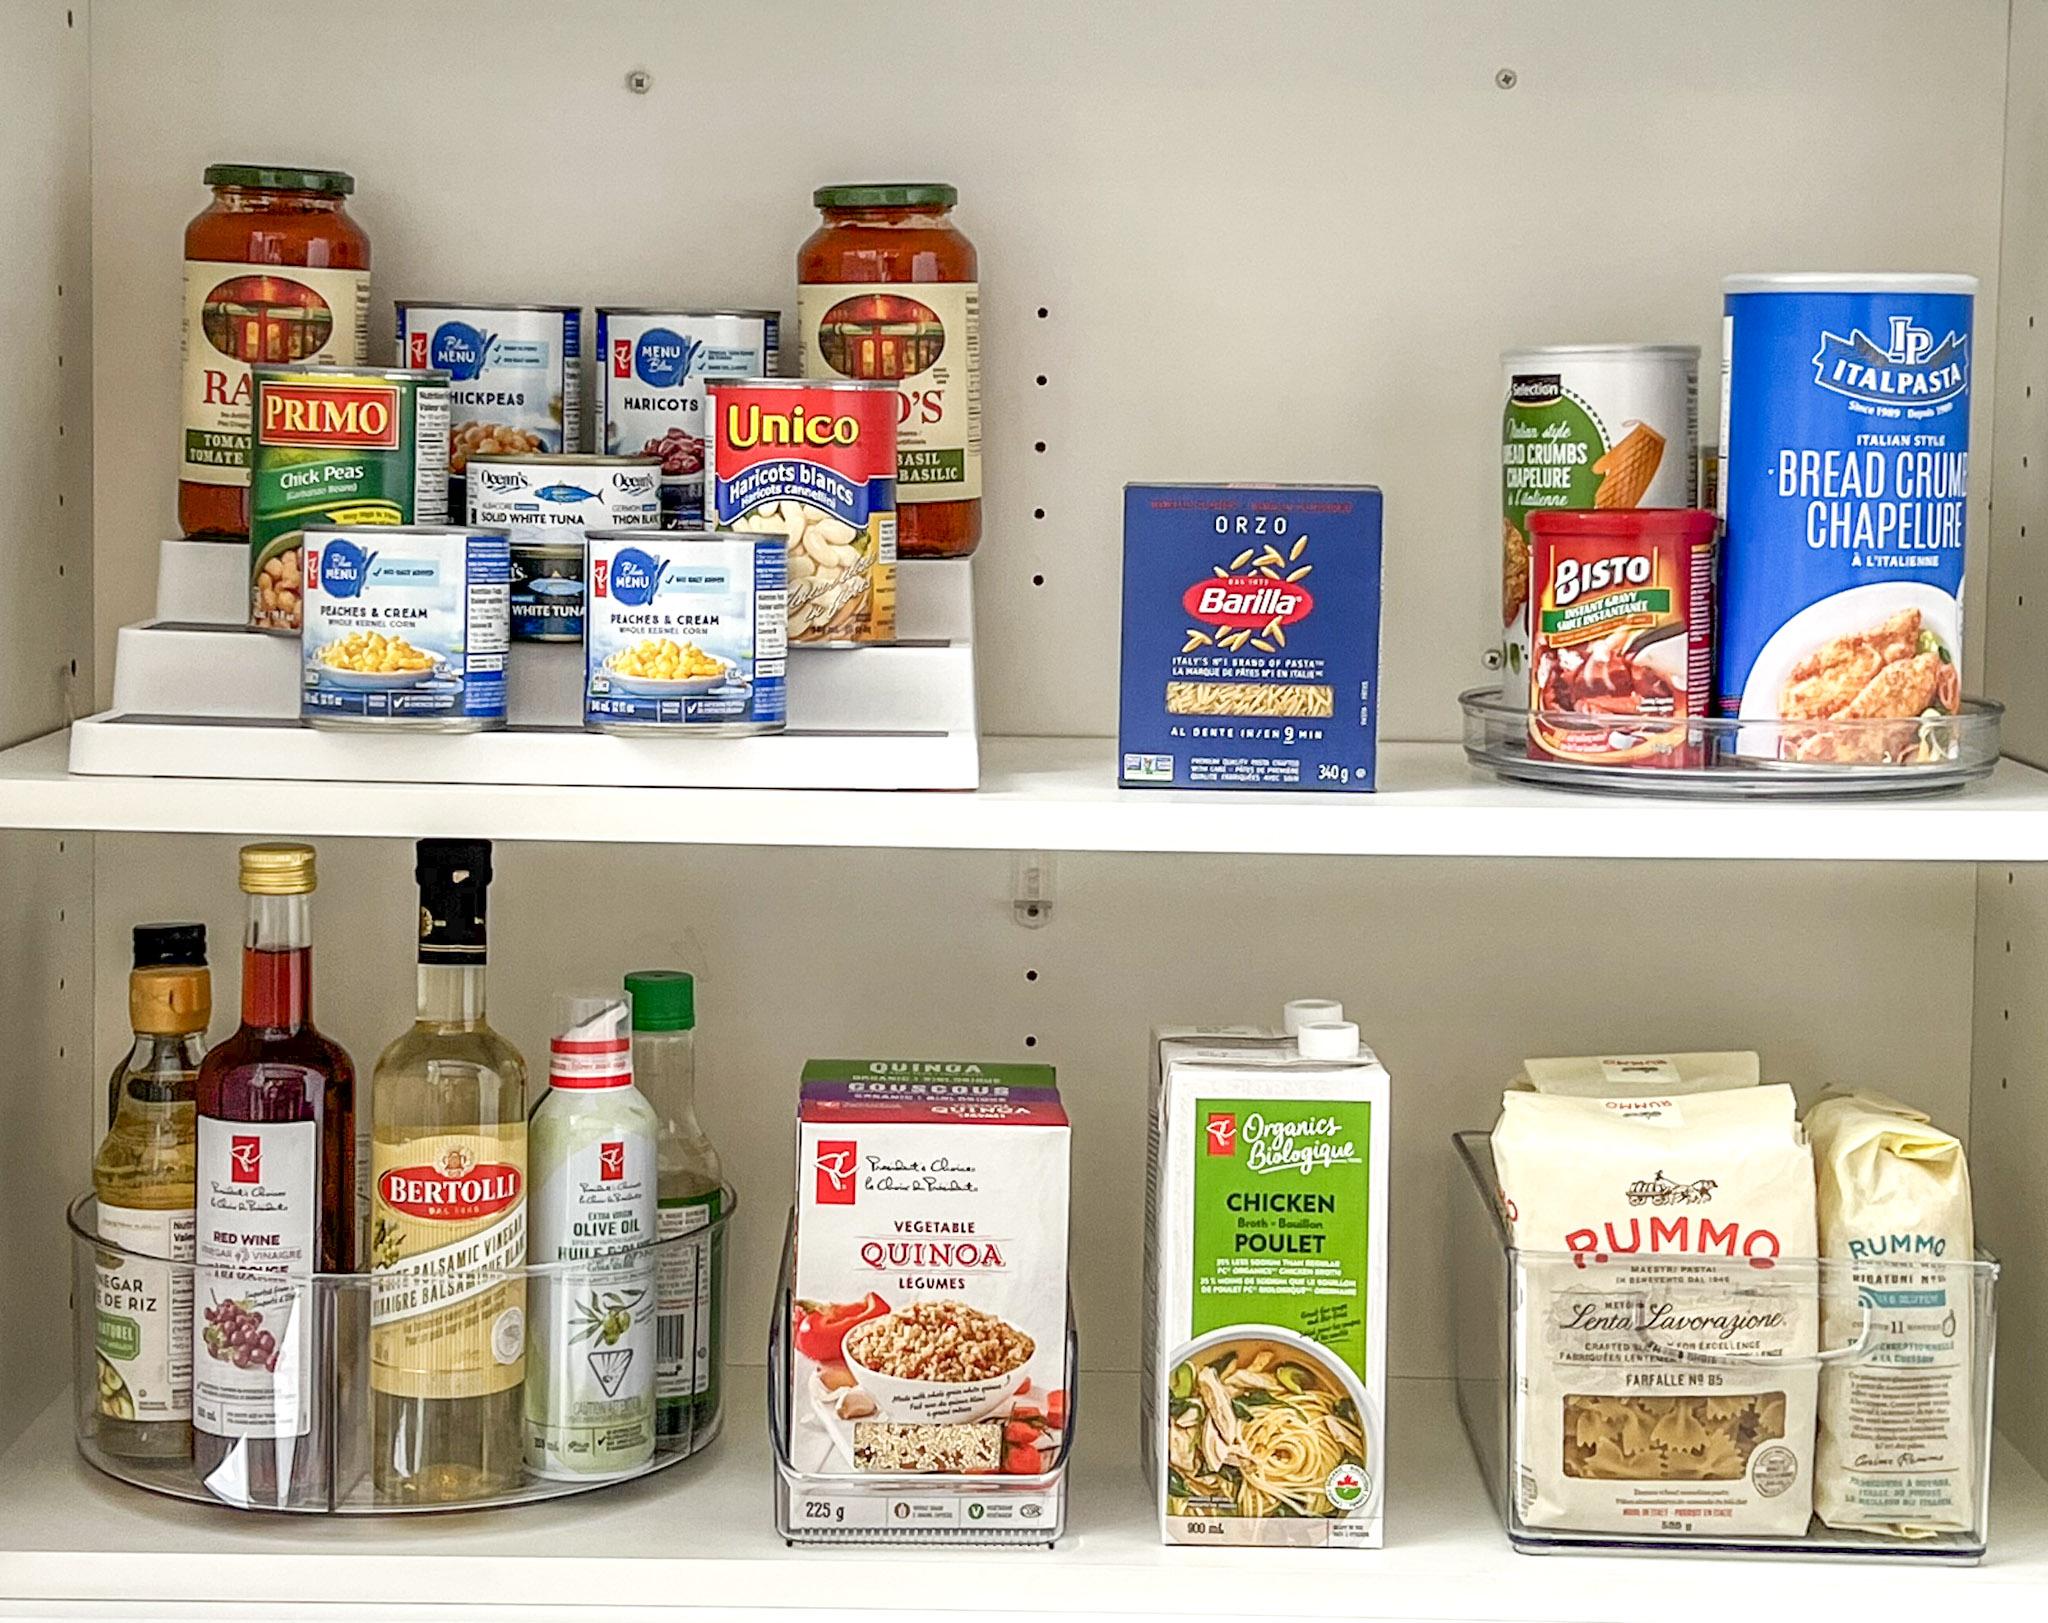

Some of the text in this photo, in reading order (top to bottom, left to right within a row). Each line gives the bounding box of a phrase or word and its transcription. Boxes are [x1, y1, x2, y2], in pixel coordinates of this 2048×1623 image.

[438, 351, 476, 364] MENU
[642, 346, 681, 359] MENU
[1832, 358, 1962, 395] ITALPASTA
[202, 369, 252, 405] RA
[1512, 383, 1558, 397] Selection
[449, 391, 525, 406] HICKPEAS
[624, 397, 699, 412] HARICOTS
[265, 394, 389, 436] PRIMO
[727, 404, 860, 448] Unico
[203, 434, 252, 450] TOMAT
[1856, 434, 1946, 447] ITALIAN STYLE
[189, 447, 244, 465] TOMATE
[1527, 442, 1588, 465] CRUMBS
[280, 465, 365, 489] Chick Peas
[481, 470, 529, 489] Ocean's
[899, 467, 958, 482] BASILIC
[1506, 466, 1572, 489] CHAPELURE
[1778, 449, 1885, 499] BREAD
[729, 464, 854, 506] Haricots blancs
[481, 512, 585, 526] SOLID WHITE TUNA
[612, 514, 640, 525] THON
[1215, 515, 1288, 535] ORZO
[1805, 500, 1963, 550] CHAPELURE
[1851, 552, 1940, 568] À L'ITALIENNE
[325, 568, 358, 580] MENU
[1554, 555, 1651, 606] BISTO
[615, 576, 650, 589] MENU
[1198, 587, 1299, 615] Barilla
[320, 605, 429, 619] PEACHES & CREAM
[512, 605, 550, 617] WHITE
[389, 620, 416, 628] CORN
[610, 614, 720, 626] PEACHES & CREAM
[682, 627, 708, 635] CORN
[1172, 657, 1281, 668] ITALY'S BRAND OF
[1172, 667, 1184, 676] LA
[1185, 668, 1220, 677] MARQUE
[1222, 668, 1233, 677] DE
[1276, 669, 1288, 678] EN
[1170, 726, 1186, 737] AL
[1193, 727, 1234, 739] DENTE
[1283, 725, 1295, 744] 9
[1298, 729, 1323, 740] MIN
[869, 1062, 982, 1074] QUINOA
[848, 1082, 1010, 1097] COUSCOUS
[930, 1106, 1032, 1115] QUINOA
[1242, 1112, 1343, 1151] Organics
[1246, 1140, 1356, 1176] Biologique
[389, 1173, 516, 1205] BERTOLLI
[1226, 1193, 1336, 1214] CHICKEN
[573, 1220, 617, 1237] OLIVE
[621, 1218, 641, 1234] OIL
[894, 1219, 976, 1234] VEGETABLE
[1237, 1216, 1324, 1230] Broth Bouillon
[213, 1230, 281, 1246] RED WINE
[1234, 1233, 1327, 1254] POULET
[1565, 1216, 1781, 1269] RUMMO
[252, 1248, 303, 1261] VINAIGRE
[413, 1213, 524, 1282] BALSAMIC VINEGAR
[1848, 1234, 1947, 1260] RUMMO
[860, 1241, 1007, 1271] QUINOA
[104, 1274, 143, 1293] EGAR
[104, 1293, 157, 1312] DE RIZ
[1560, 1303, 1784, 1340] Lenta Lavorazione
[1891, 1320, 1904, 1334] 11
[1584, 1341, 1633, 1351] CRAFTED
[1699, 1340, 1761, 1350] EXCELLENCE
[1625, 1374, 1724, 1387] FARFALLE 85
[805, 1501, 845, 1522] 225 g
[1187, 1522, 1204, 1534] 900
